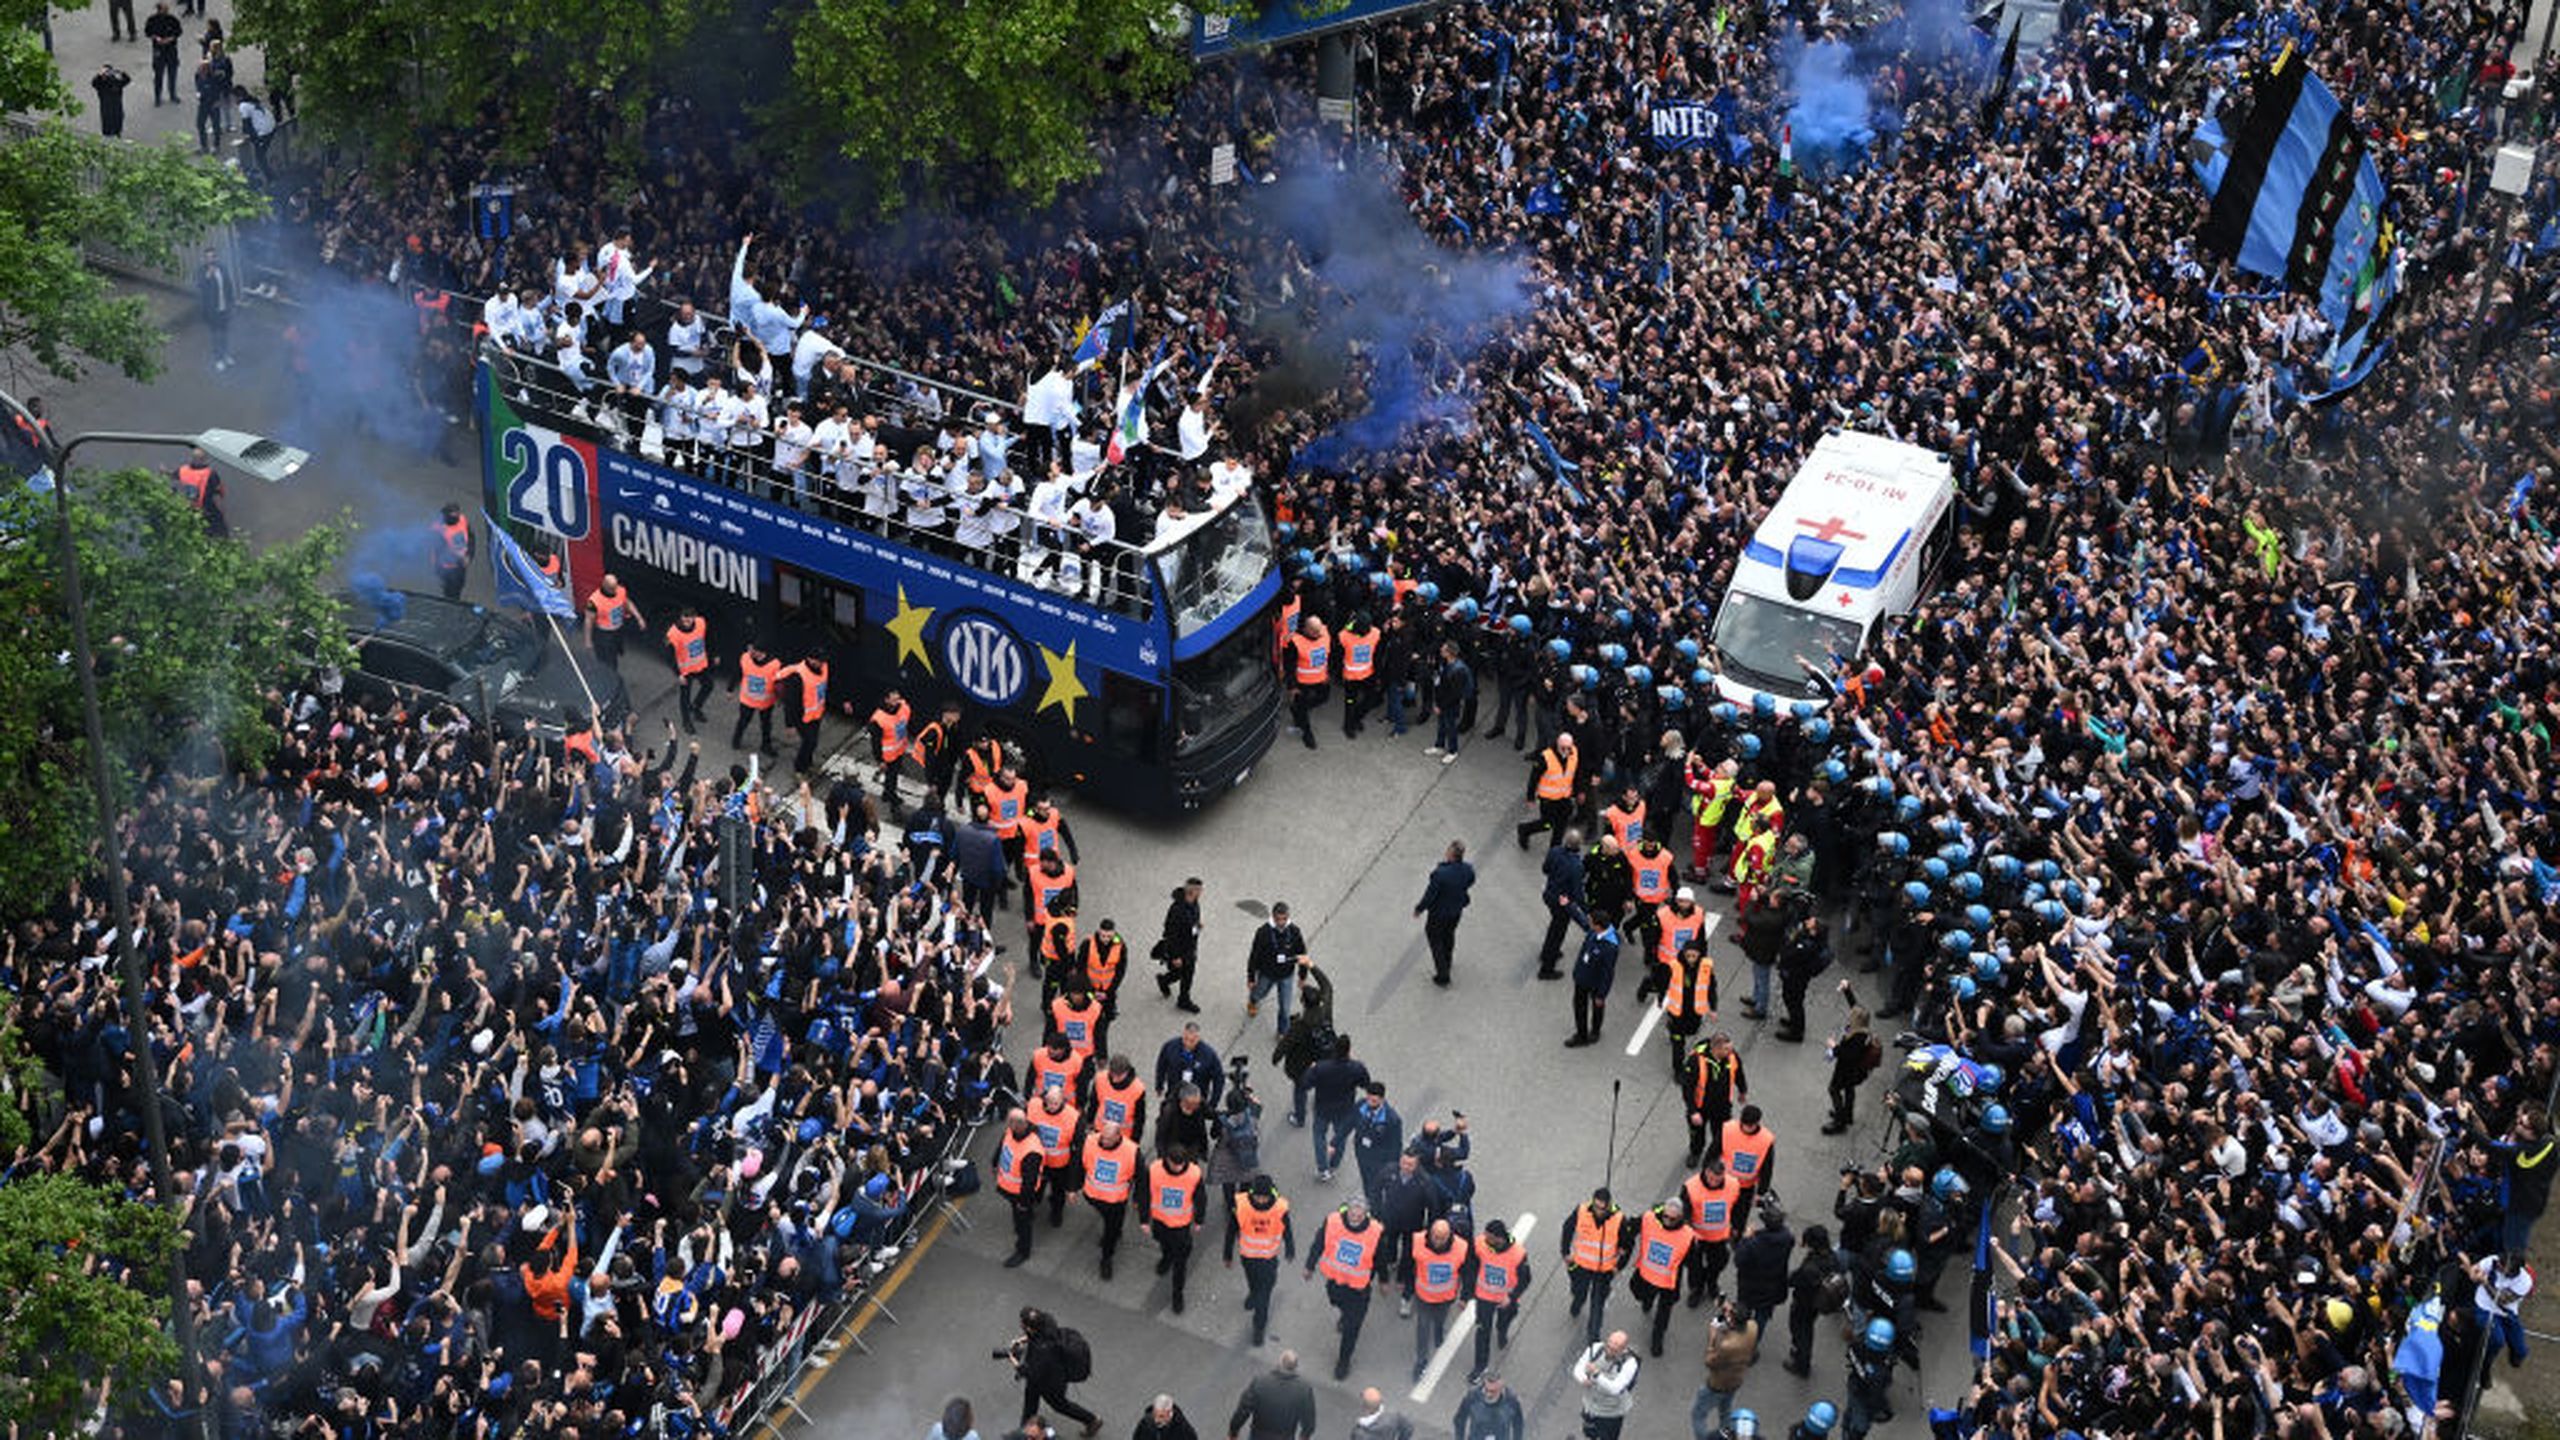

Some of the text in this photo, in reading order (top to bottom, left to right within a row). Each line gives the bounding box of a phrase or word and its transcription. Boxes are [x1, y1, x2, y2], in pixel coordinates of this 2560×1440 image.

[1652, 106, 1719, 139] INTER
[502, 427, 591, 541] 20
[611, 512, 759, 601] CAMPIONI
